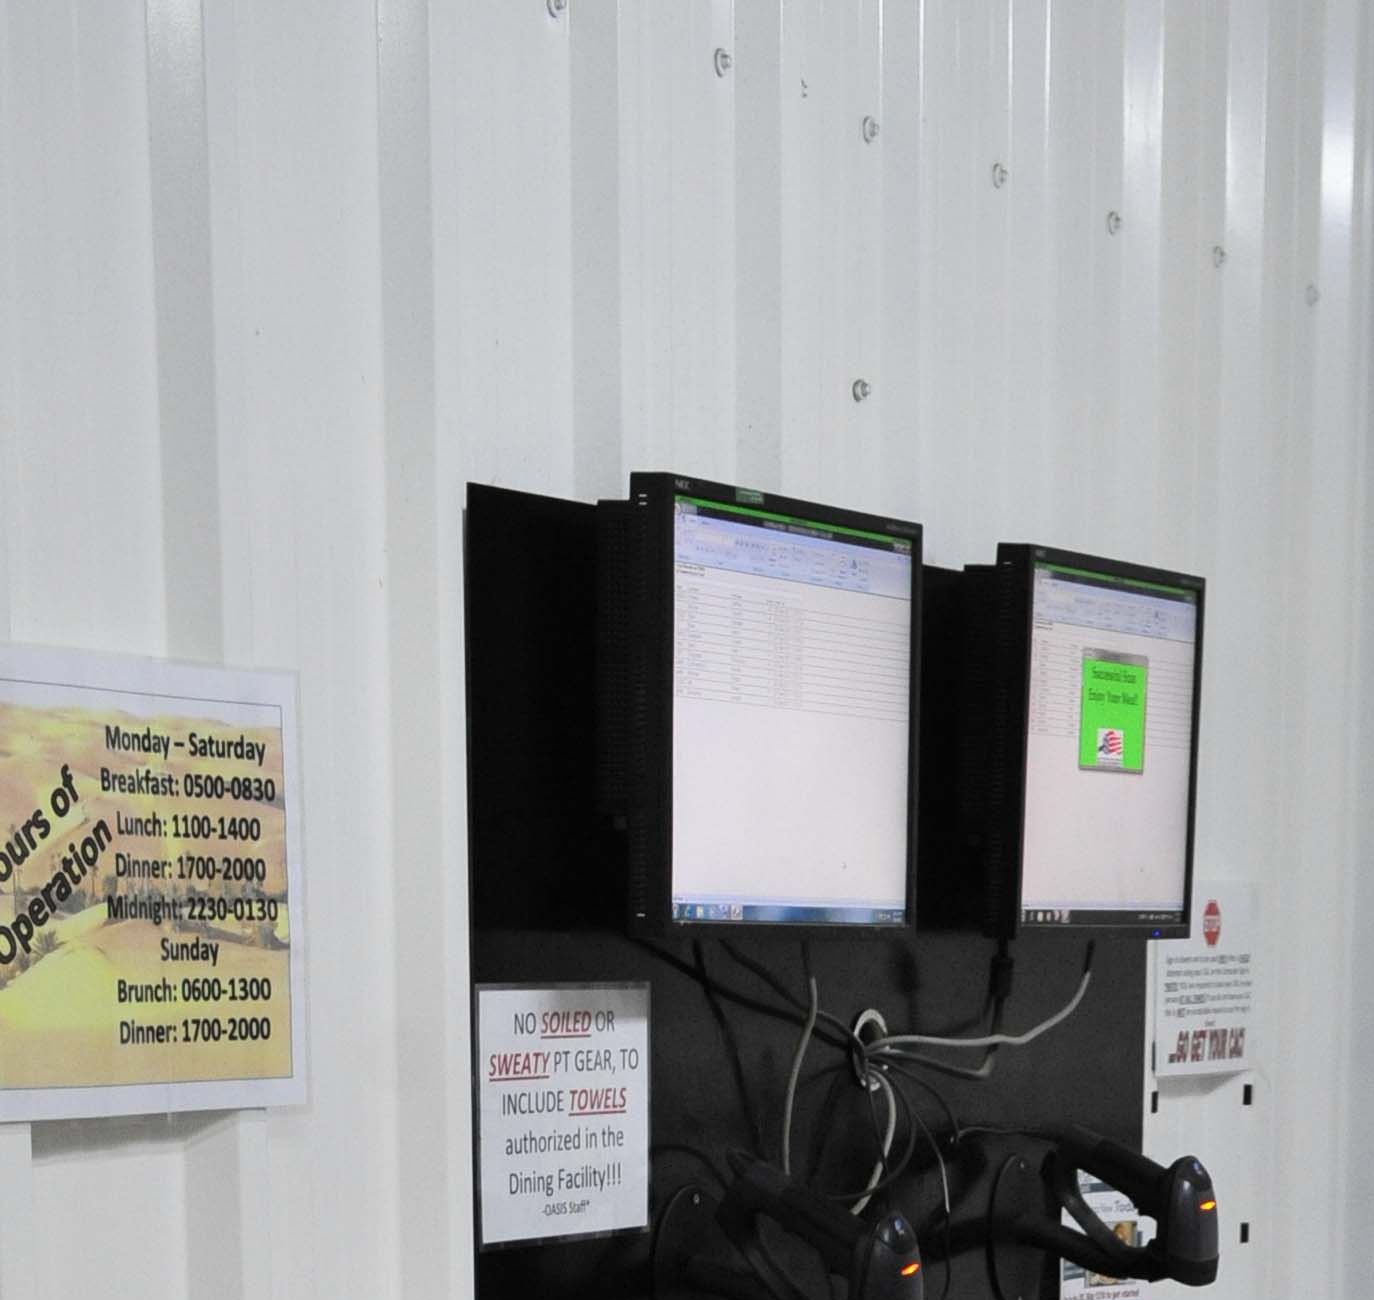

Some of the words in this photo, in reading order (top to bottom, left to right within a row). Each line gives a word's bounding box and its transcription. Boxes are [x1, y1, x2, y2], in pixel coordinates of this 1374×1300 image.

[105, 725, 169, 760] Monday
[188, 733, 266, 764] Saturday
[51, 763, 79, 818] of
[101, 767, 180, 797] Breakfast:
[183, 773, 276, 802] 0500-0830
[117, 811, 168, 838] Lunch:
[172, 814, 261, 842] 1100-1400
[115, 853, 172, 880] Dinner:
[177, 855, 266, 882] 1700-2000
[0, 818, 112, 965] Operation
[107, 897, 183, 926] Midnight:
[187, 896, 279, 922] 2230-0130
[160, 937, 219, 966] Sunday
[117, 978, 177, 1004] Brunch:
[181, 977, 271, 1002] 0600-1300
[119, 1018, 177, 1045] Dinner:
[182, 1016, 271, 1043] 1700-2000
[514, 1012, 537, 1035] NO
[540, 1010, 592, 1035] SOILED
[595, 1010, 616, 1033] OR
[488, 1051, 551, 1077] SWEATY
[554, 1050, 571, 1074] PT
[574, 1049, 616, 1074] GEAR,
[620, 1048, 640, 1071] TO
[502, 1090, 565, 1115] INCLUDE
[569, 1087, 627, 1112] TOWELS
[505, 1127, 581, 1155] authorized
[585, 1127, 598, 1150] in
[602, 1125, 624, 1149] the
[509, 1171, 554, 1197] Dining
[557, 1162, 622, 1191] Facility!!!
